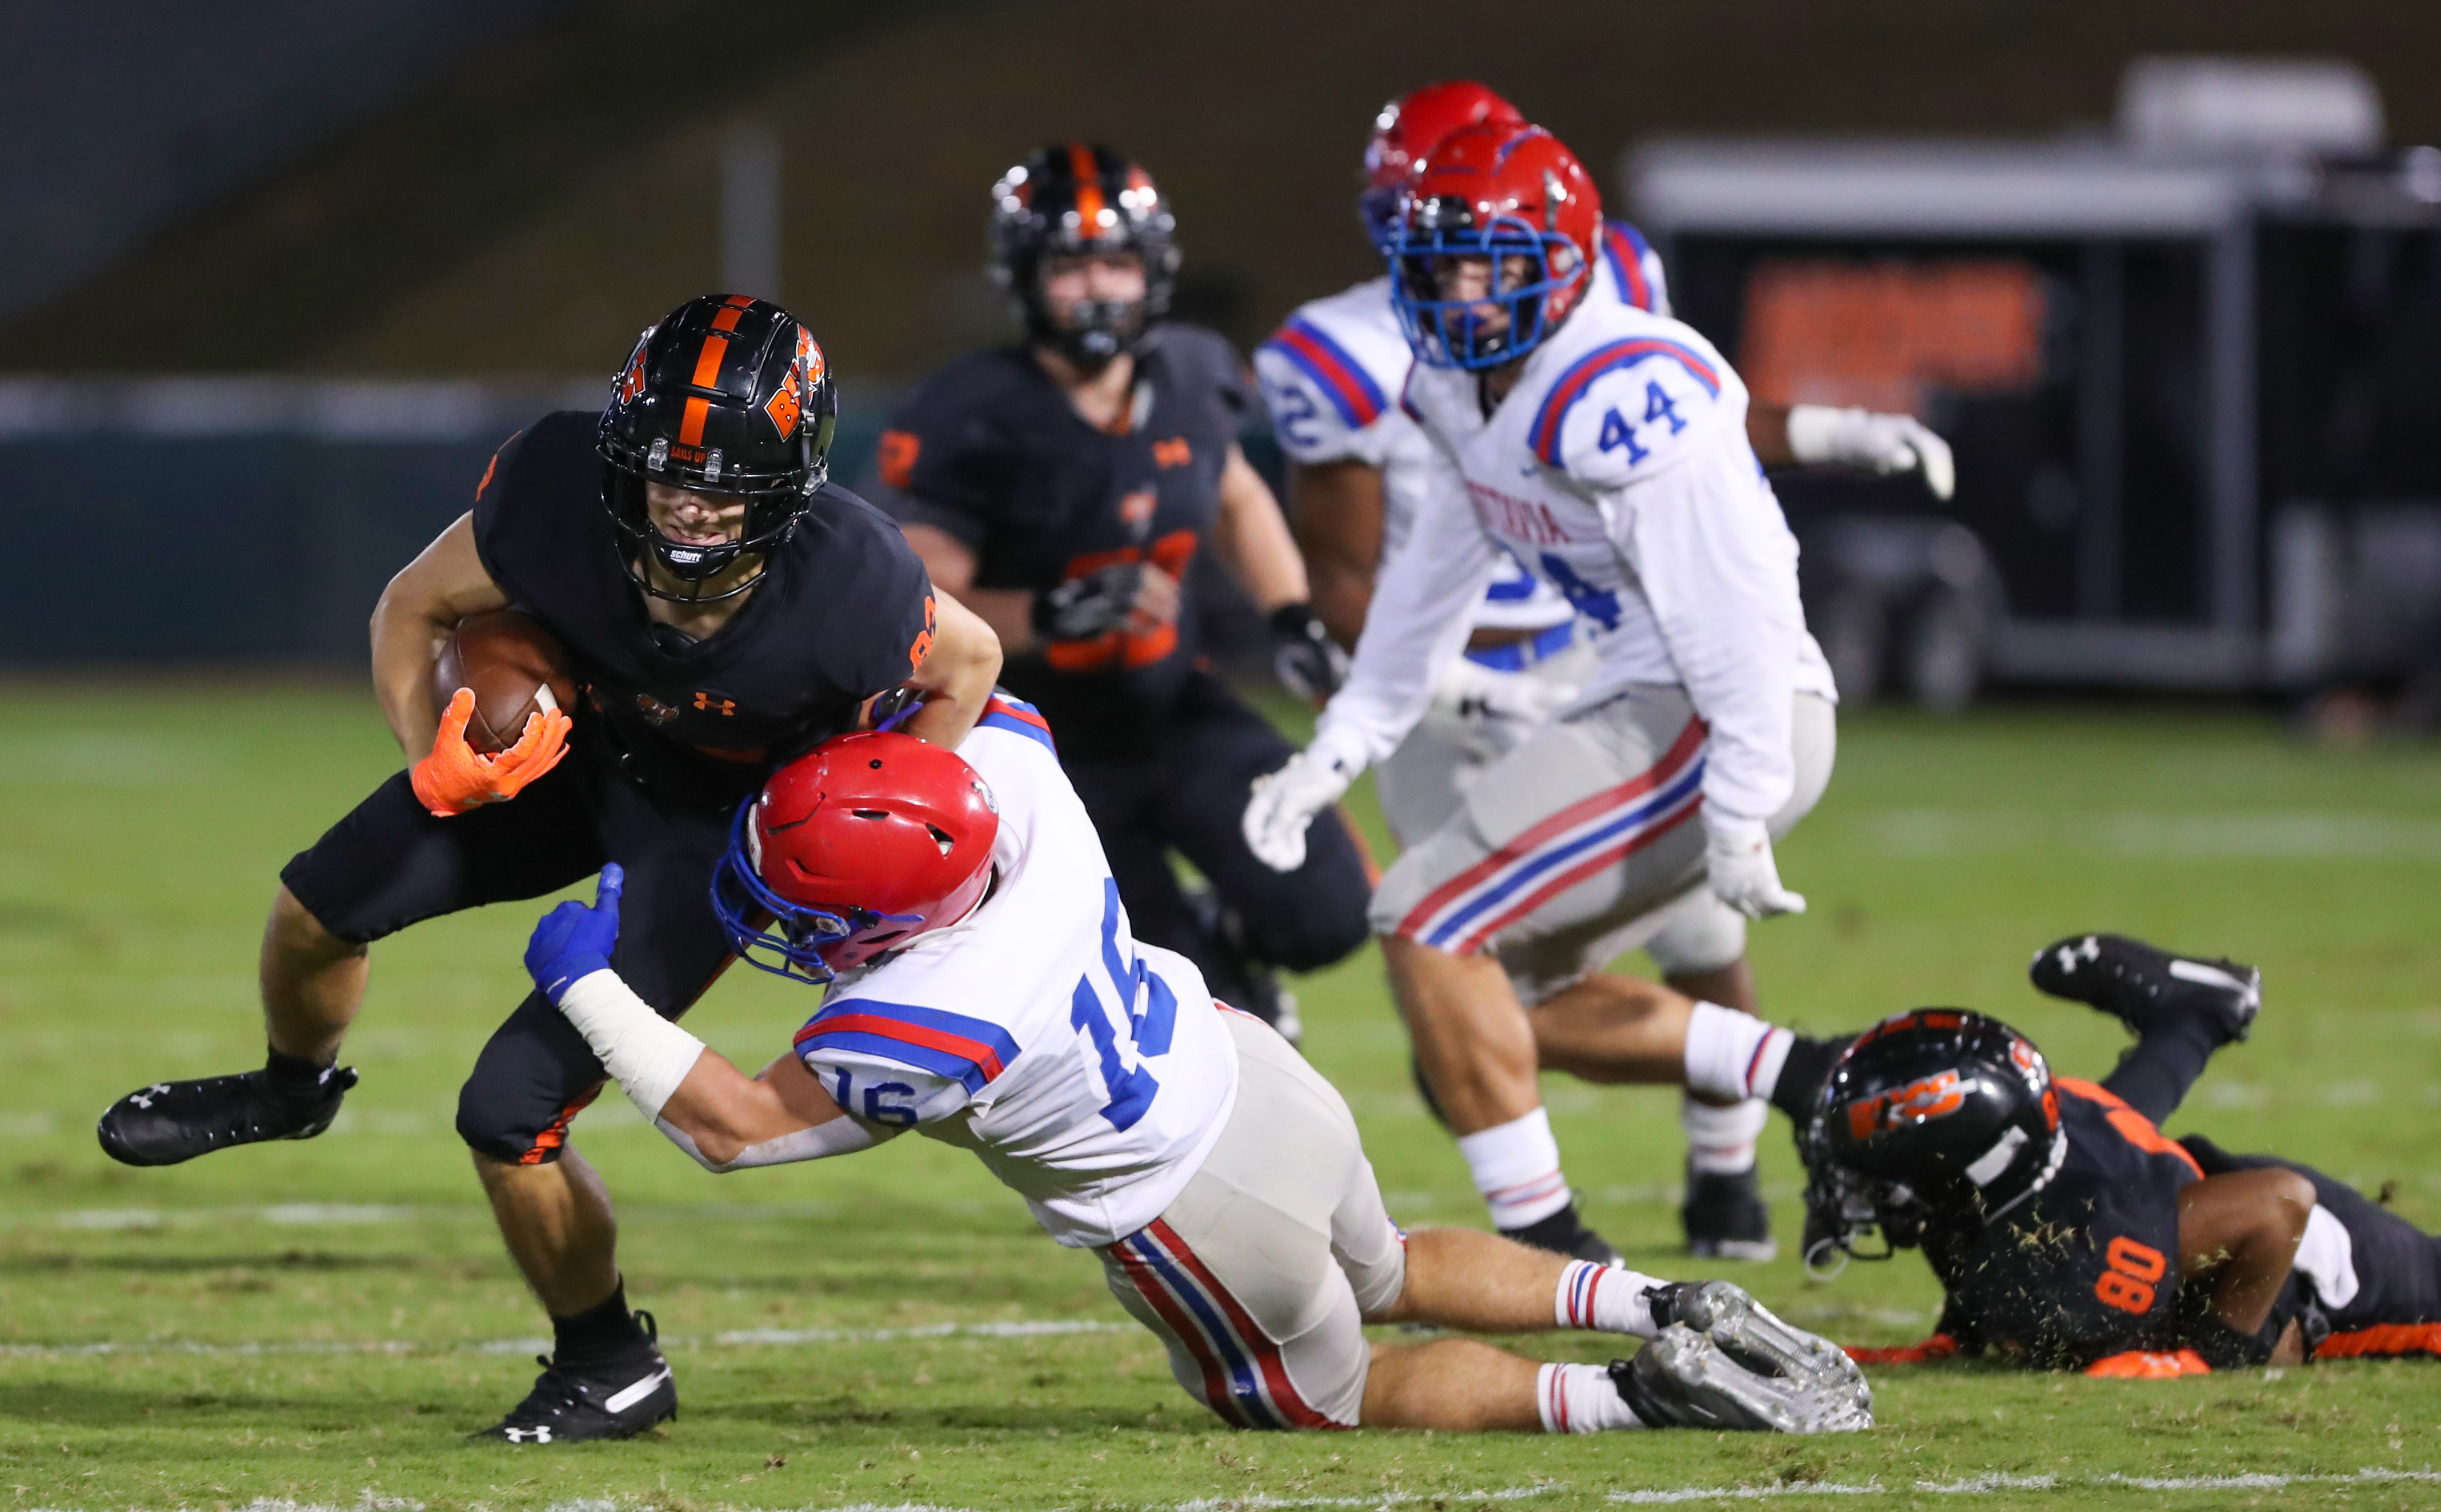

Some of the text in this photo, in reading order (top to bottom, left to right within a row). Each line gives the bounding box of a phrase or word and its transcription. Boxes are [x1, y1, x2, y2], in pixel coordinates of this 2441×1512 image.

[671, 446, 707, 463] SAILS UP
[1599, 379, 1686, 467] 44
[1071, 877, 1177, 1132] 16
[835, 1067, 918, 1126] 16
[2095, 1236, 2166, 1315] 80
